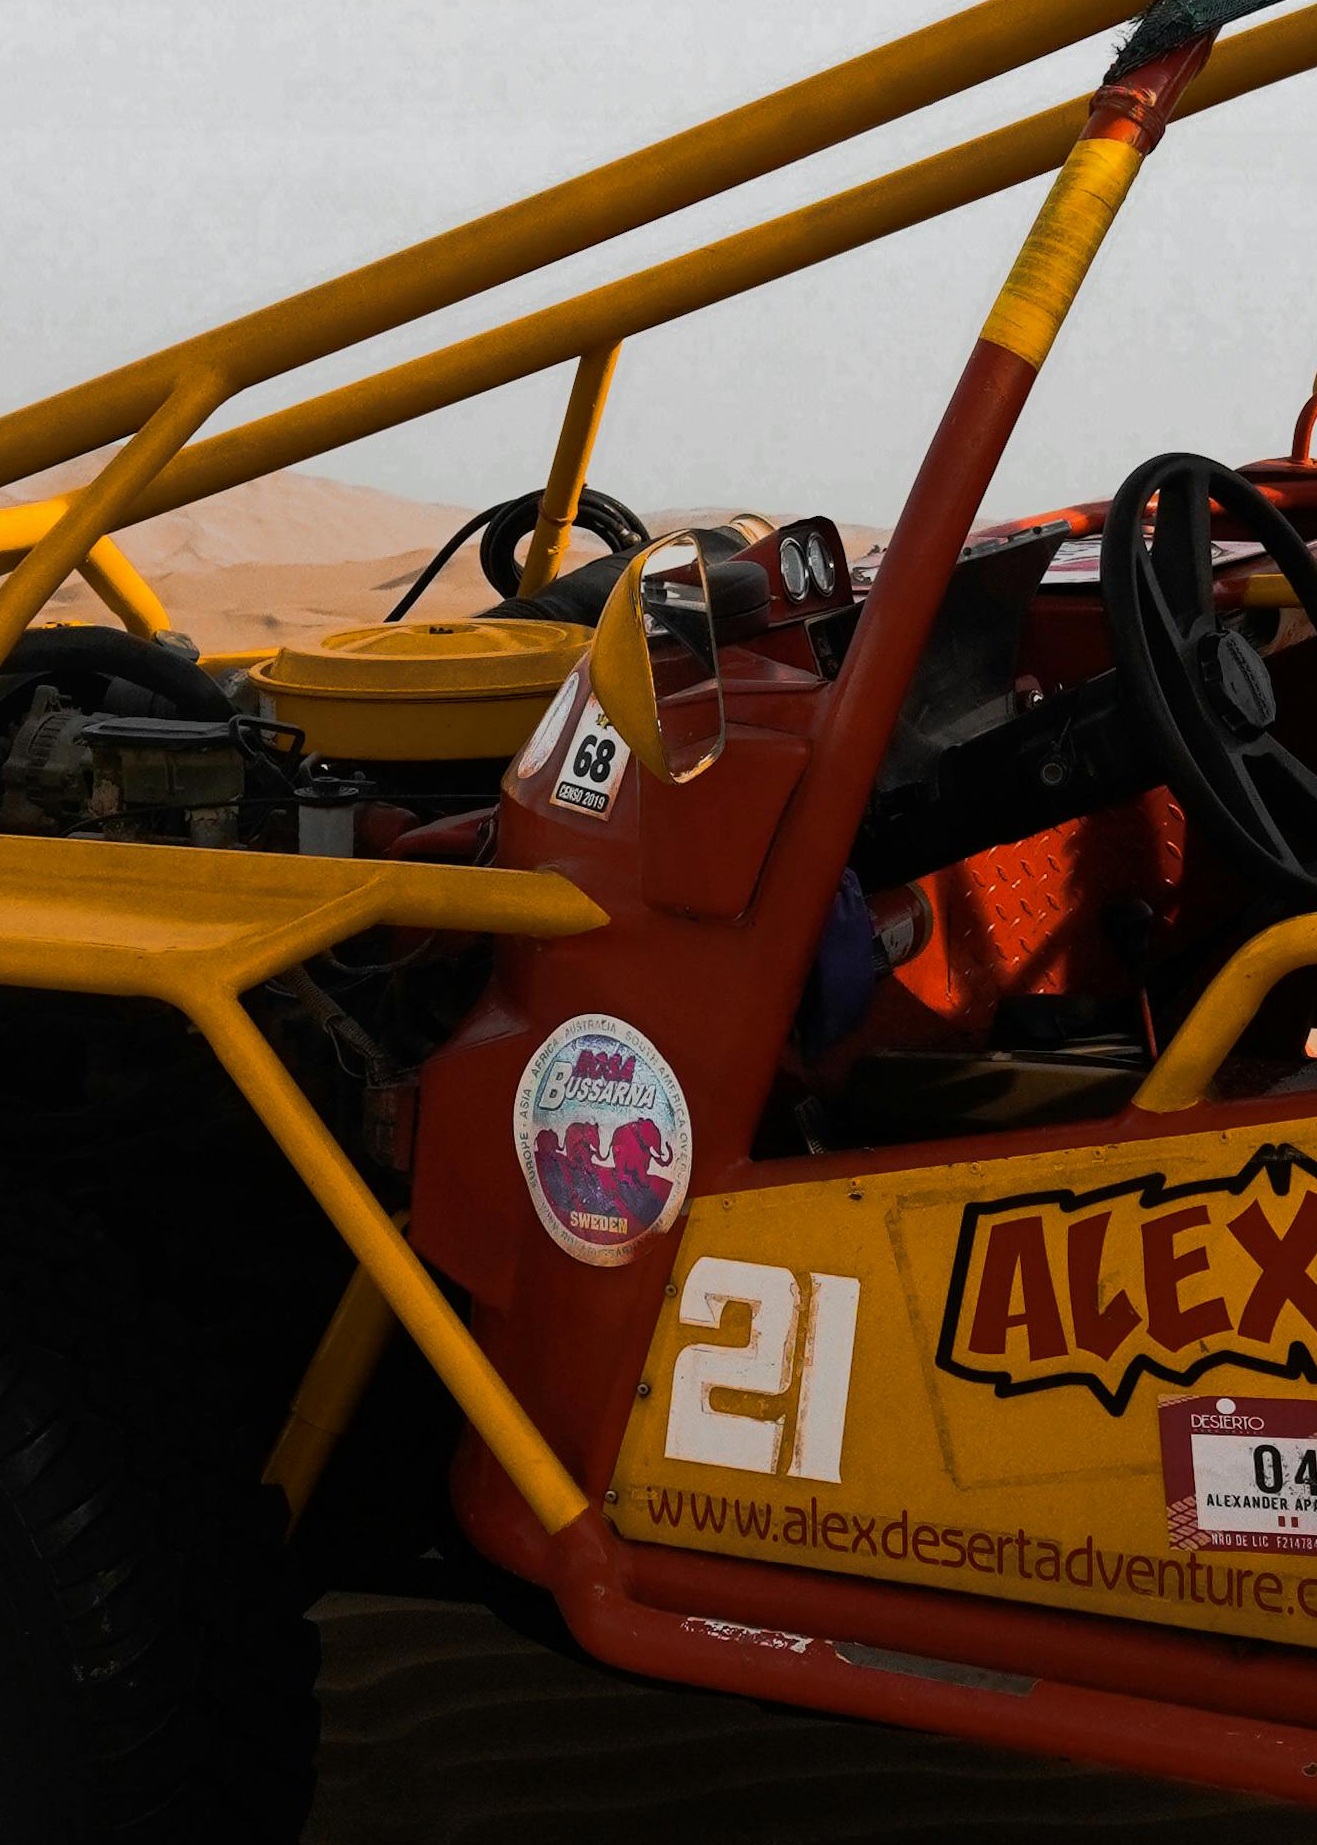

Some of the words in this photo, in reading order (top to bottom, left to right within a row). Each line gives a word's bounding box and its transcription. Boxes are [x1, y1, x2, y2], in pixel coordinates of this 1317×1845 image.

[572, 734, 616, 783] 68
[558, 784, 584, 802] CENSO
[583, 794, 606, 810] 2019
[564, 1019, 617, 1037] AUSTRALIA
[532, 1039, 559, 1079] AFRICA
[538, 1060, 656, 1111] BUSSARNA
[658, 1066, 685, 1128] AMERICA
[520, 1089, 533, 1120] ASIA
[519, 1132, 537, 1188] EUROPE
[569, 1210, 628, 1235] SWEDEN
[664, 1256, 861, 1484] 21
[1190, 1414, 1265, 1431] DESIERTO
[1206, 1493, 1288, 1511] ALEXANDER
[1211, 1534, 1232, 1546] NRO
[1236, 1535, 1247, 1547] DE
[1252, 1535, 1269, 1547] LIC
